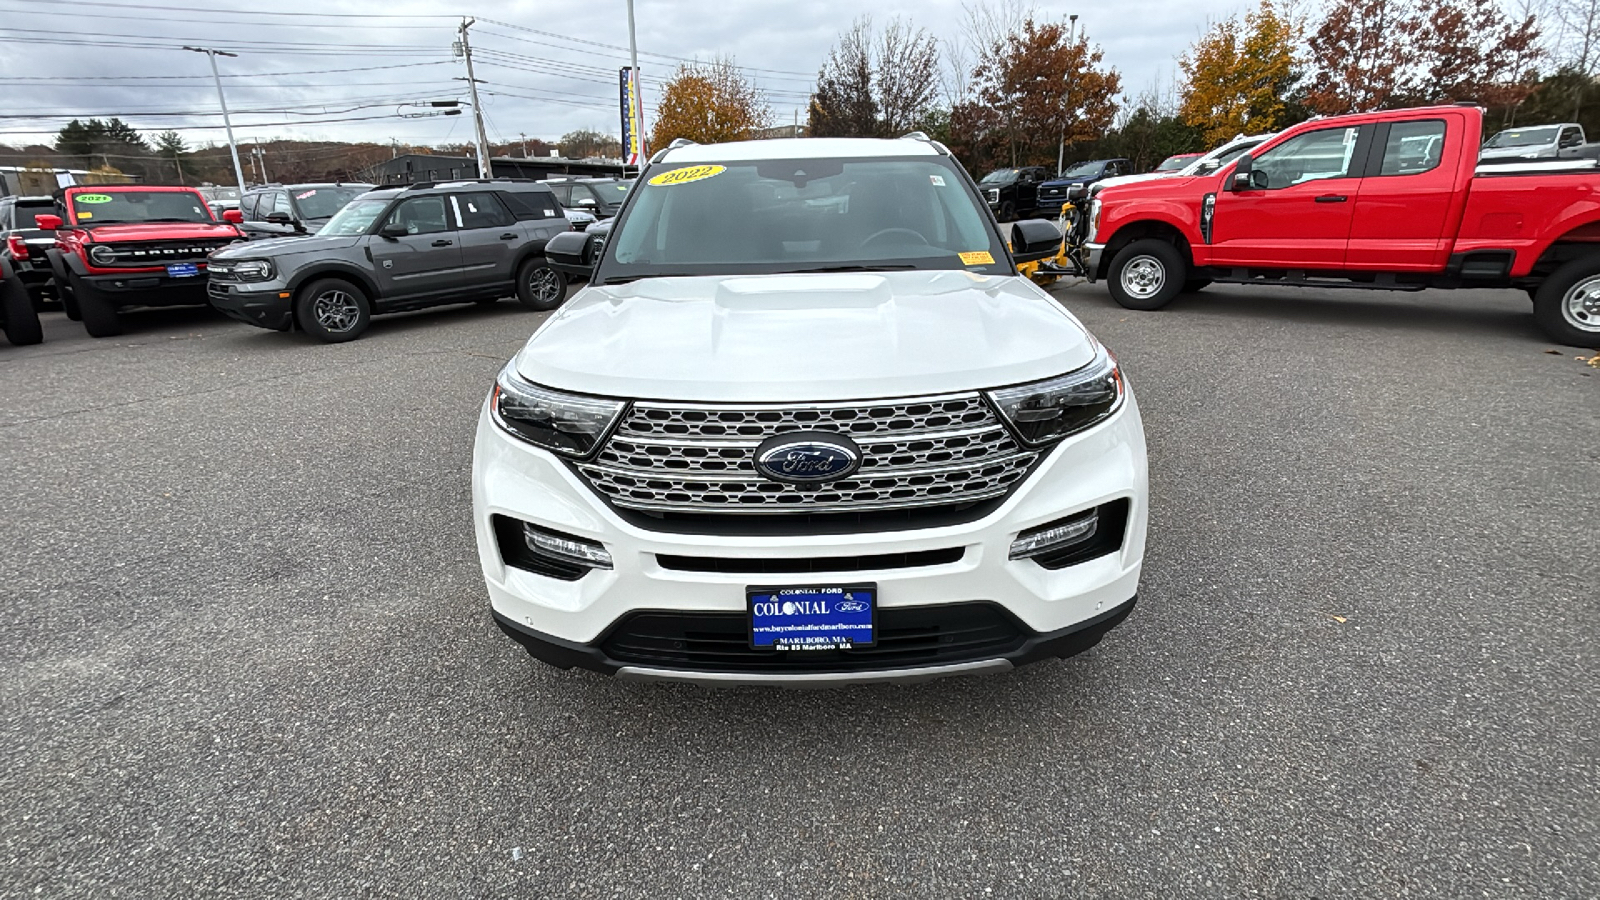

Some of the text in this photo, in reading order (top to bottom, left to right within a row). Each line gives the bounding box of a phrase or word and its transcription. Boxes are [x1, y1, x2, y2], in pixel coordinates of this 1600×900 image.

[661, 166, 713, 184] 2022
[134, 247, 216, 256] BRONCO
[783, 451, 834, 472] Ford
[753, 601, 830, 616] COLONIAL
[841, 602, 863, 611] Ford
[753, 623, 873, 633] www.buycolonialfordmarlboro.com
[802, 643, 836, 651] Marlboro
